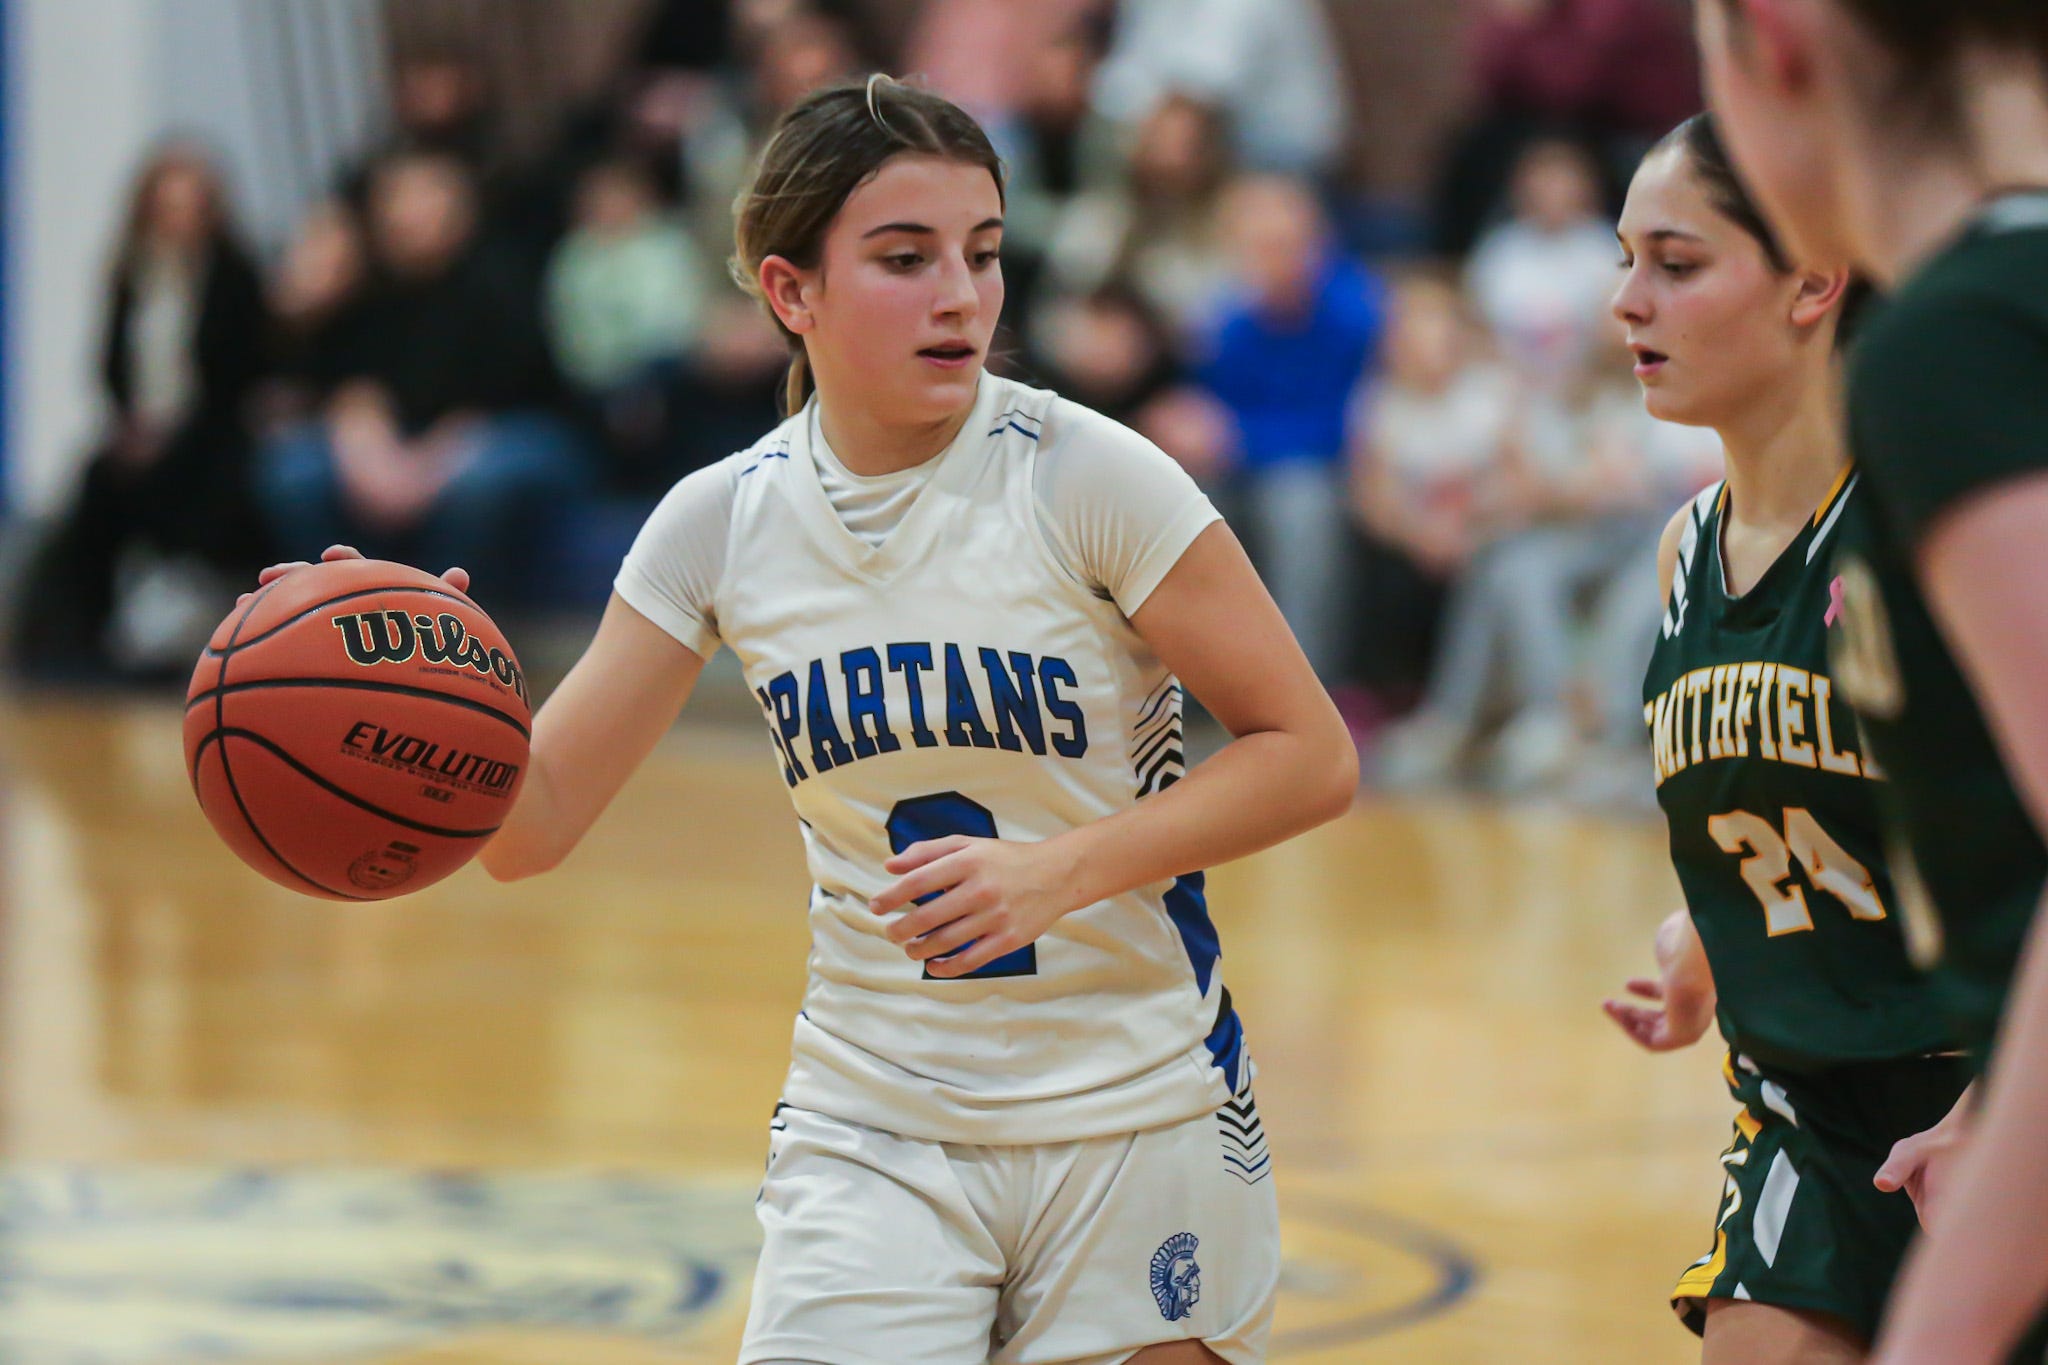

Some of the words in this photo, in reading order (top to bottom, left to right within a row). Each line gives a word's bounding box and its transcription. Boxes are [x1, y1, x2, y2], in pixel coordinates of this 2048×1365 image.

[332, 609, 529, 710] Wilson
[343, 721, 519, 791] EVOLUTION
[1644, 661, 1888, 789] MITHFIEL
[1707, 806, 1887, 938] 24
